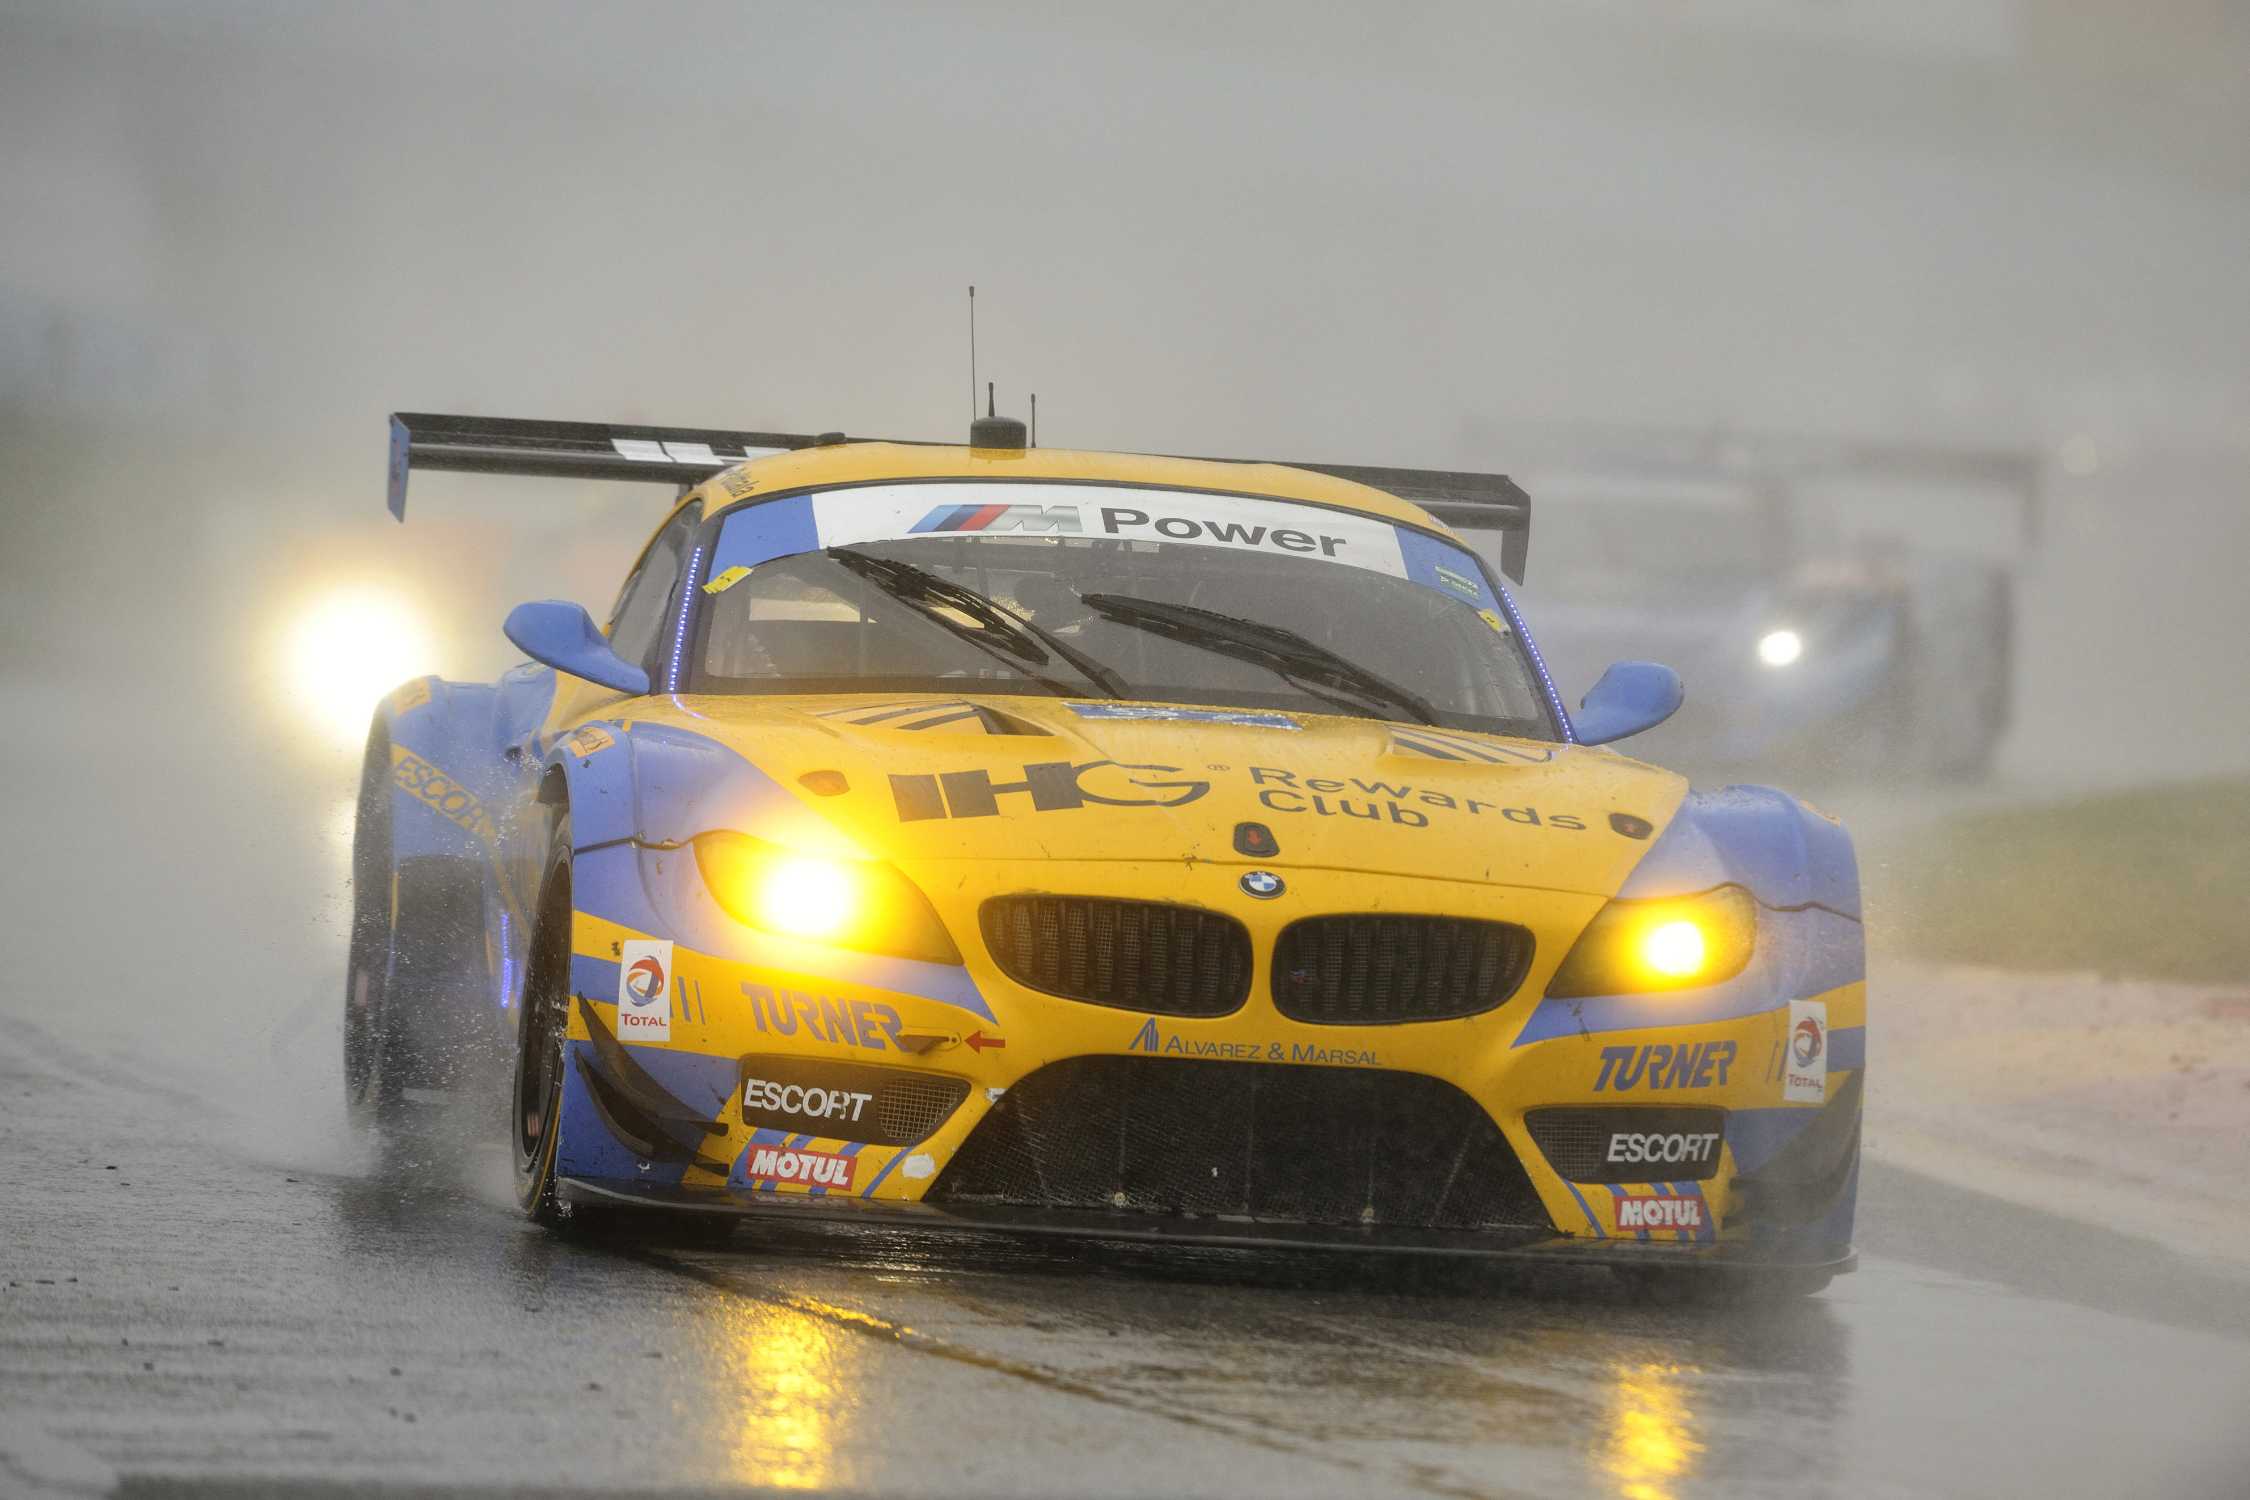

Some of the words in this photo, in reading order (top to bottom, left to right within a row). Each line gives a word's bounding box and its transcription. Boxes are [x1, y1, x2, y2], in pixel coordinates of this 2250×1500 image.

[1099, 506, 1348, 558] Power
[397, 754, 494, 838] ESCOR
[887, 759, 1211, 823] IHG
[1248, 765, 1587, 831] Rewards
[1258, 788, 1430, 828] Club
[621, 1012, 668, 1027] TOTAL
[740, 981, 910, 1053] TURNER
[1164, 1034, 1261, 1060] ALVAREZ
[1267, 1042, 1286, 1062] &
[1291, 1043, 1383, 1066] MARSAL
[1592, 1039, 1738, 1092] TURNER
[742, 1077, 873, 1122] ESCORT
[1787, 1073, 1824, 1090] TOTAL
[750, 1148, 851, 1187] MOTUL
[1606, 1132, 1719, 1163] ESCORT
[1620, 1199, 1701, 1227] MOTUL
